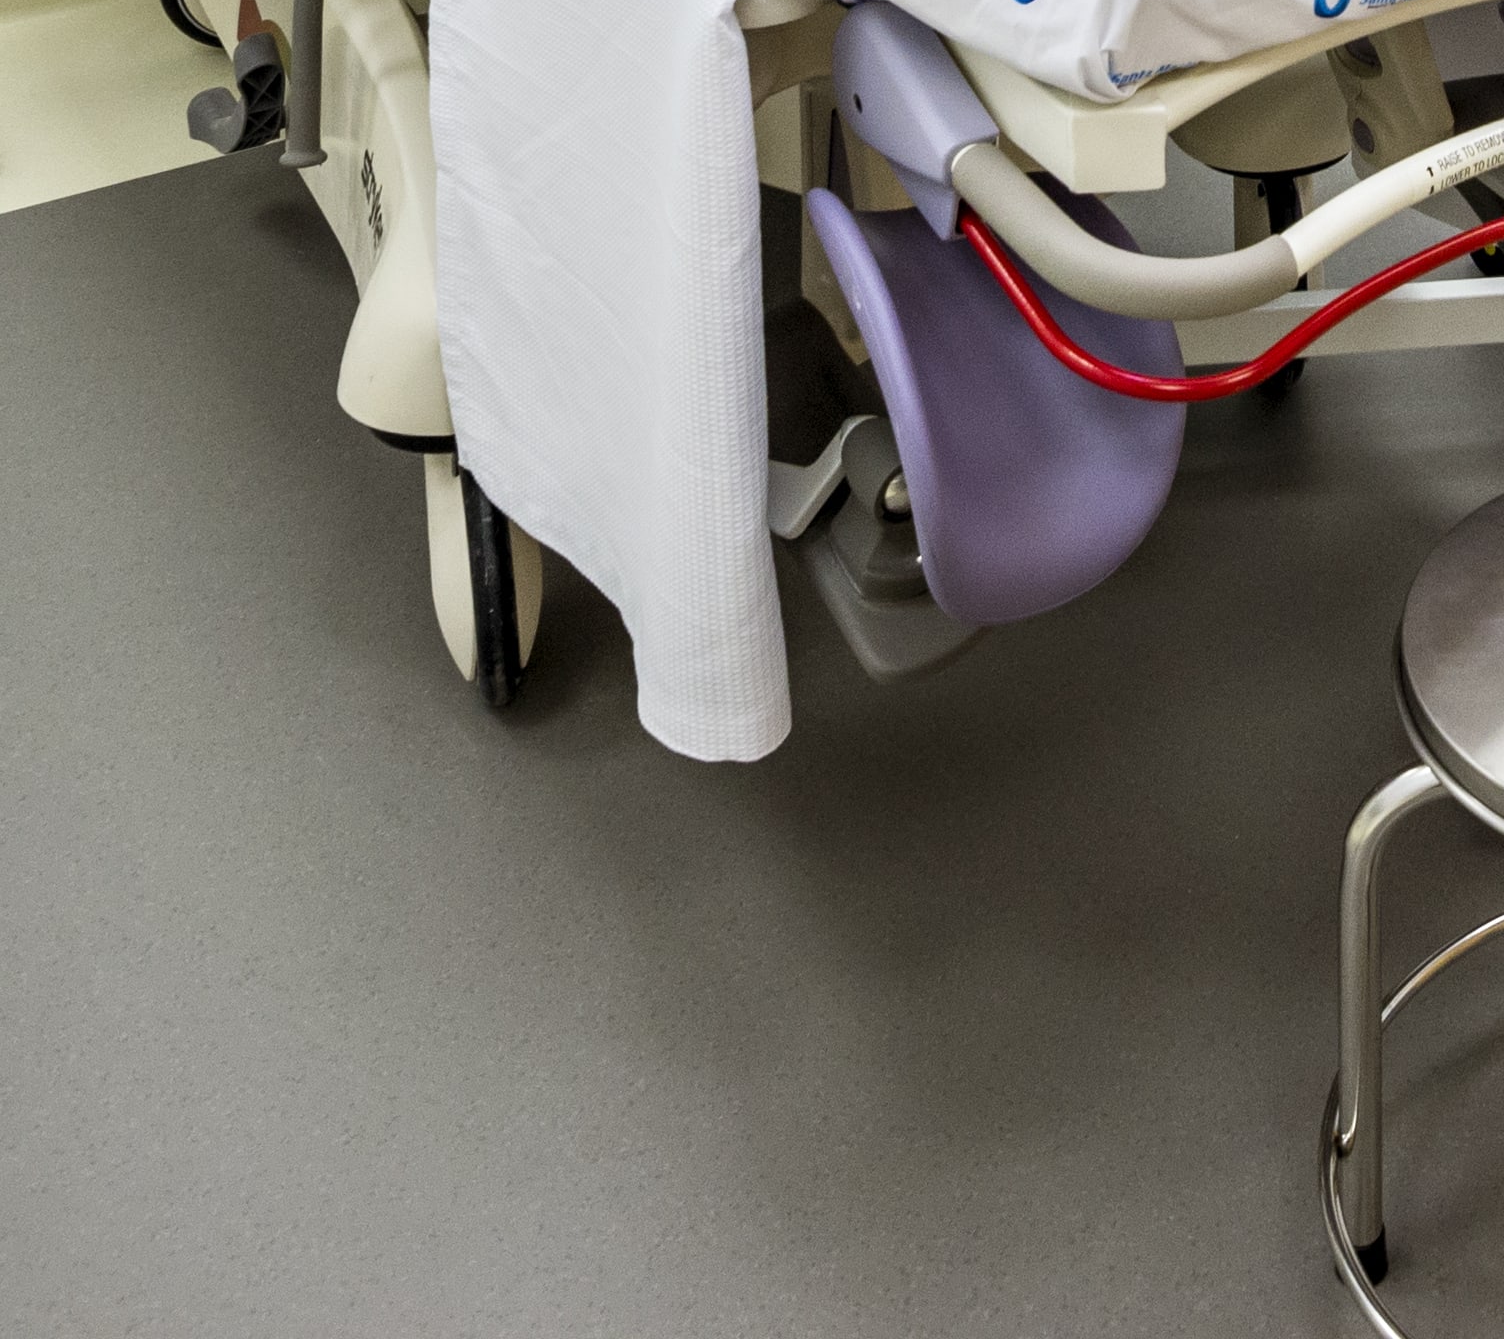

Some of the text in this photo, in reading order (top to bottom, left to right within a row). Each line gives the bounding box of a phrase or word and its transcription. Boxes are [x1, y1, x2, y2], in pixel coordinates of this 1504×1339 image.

[1437, 151, 1464, 171] RAISE
[1463, 145, 1476, 158] TO
[1440, 165, 1471, 190] LOWER
[1473, 159, 1486, 173] TO
